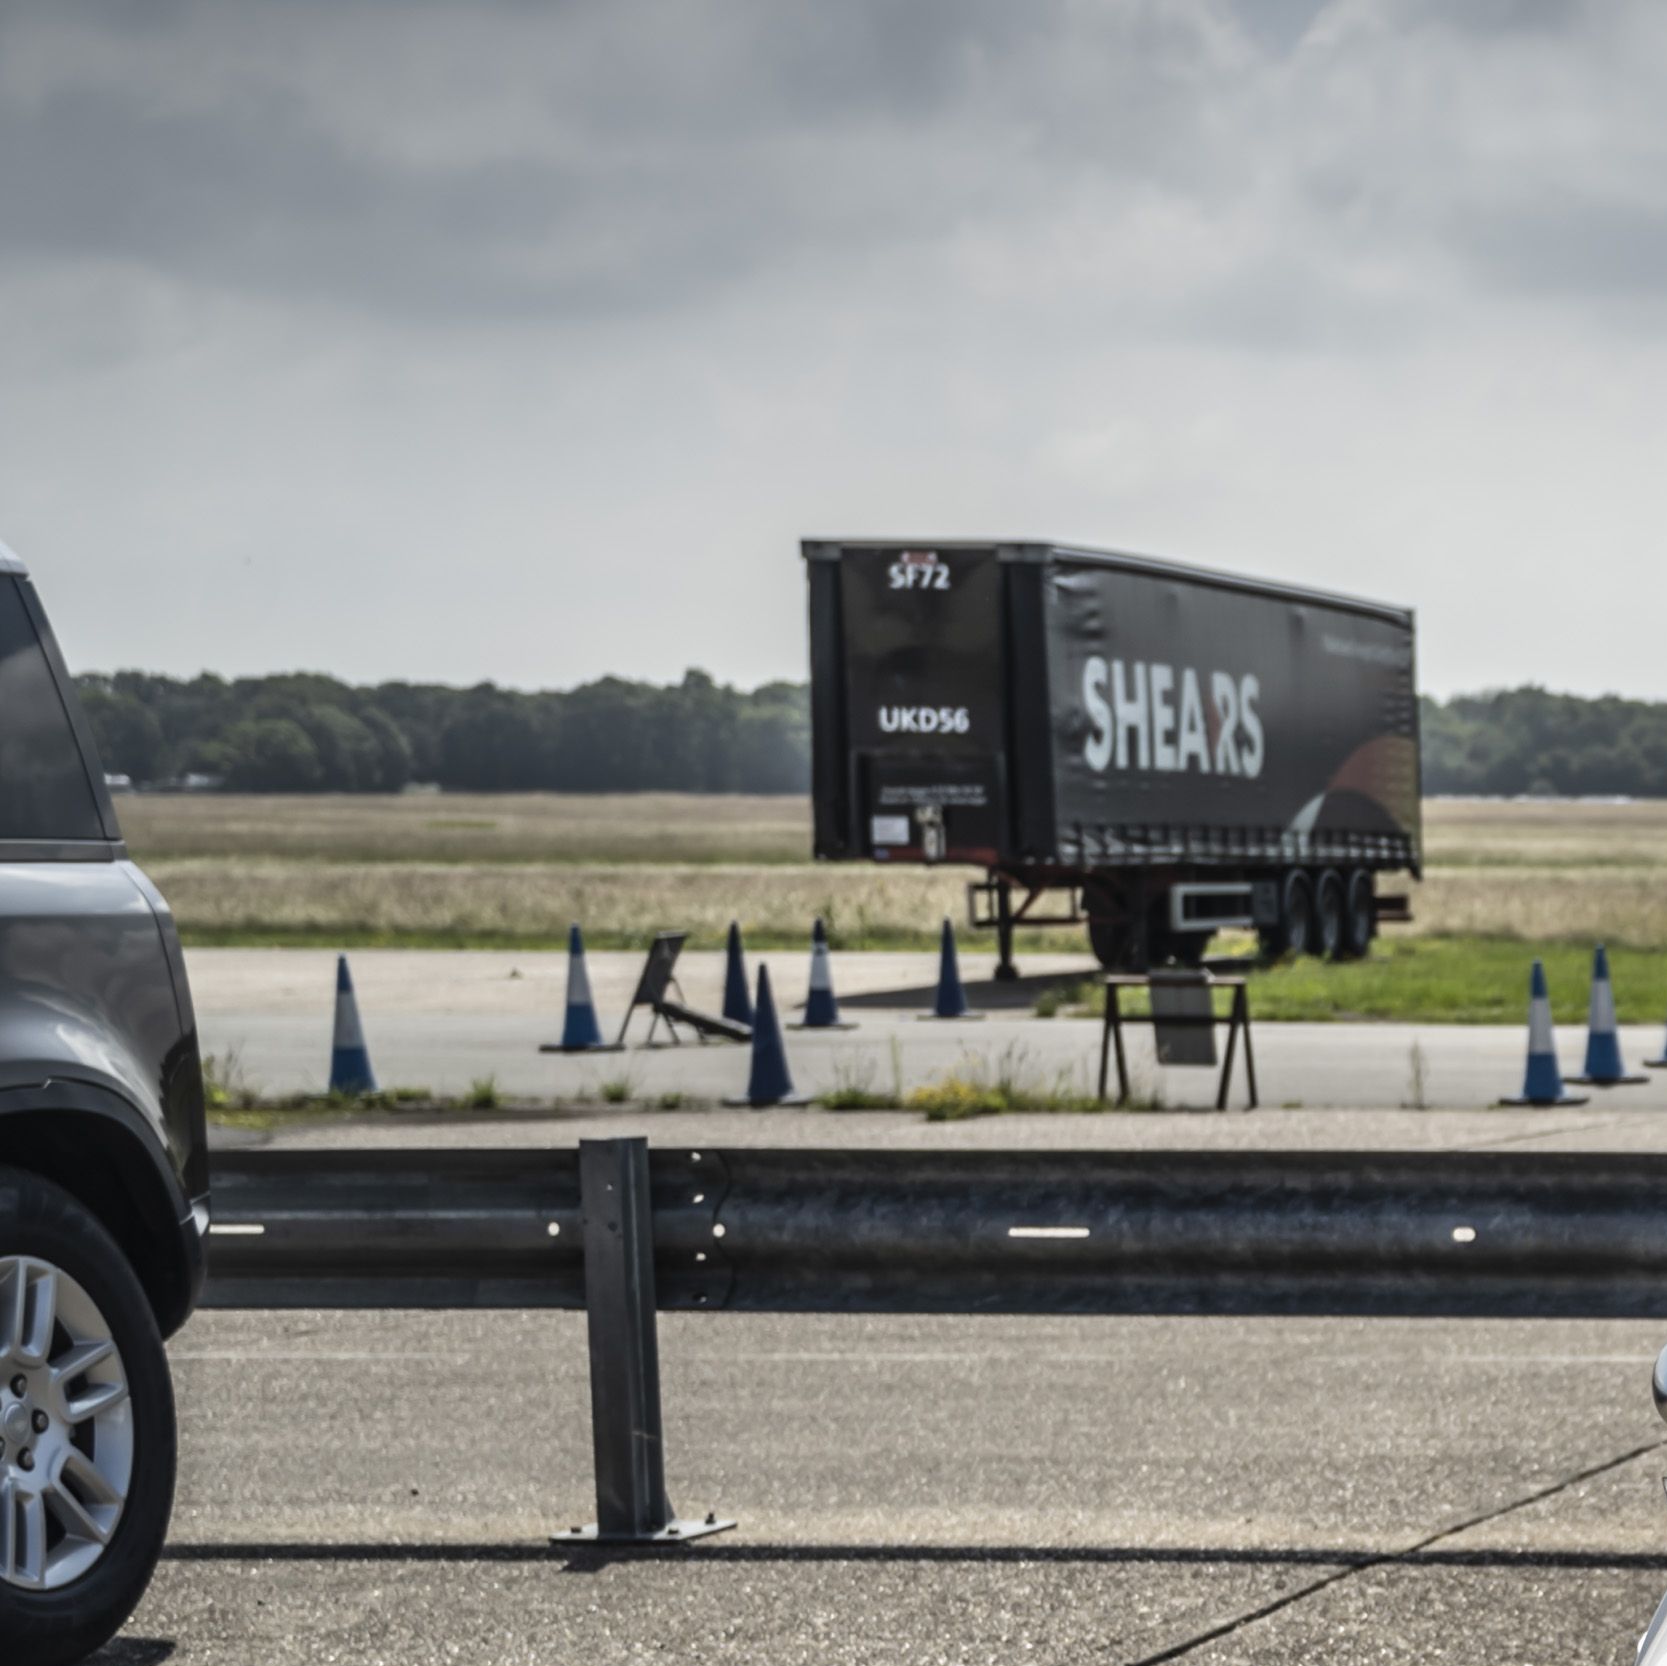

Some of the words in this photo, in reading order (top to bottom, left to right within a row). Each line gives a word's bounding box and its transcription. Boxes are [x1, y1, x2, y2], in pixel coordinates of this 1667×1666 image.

[889, 563, 951, 590] SF72
[879, 705, 970, 734] UKD56
[1083, 655, 1264, 780] SHEARS
